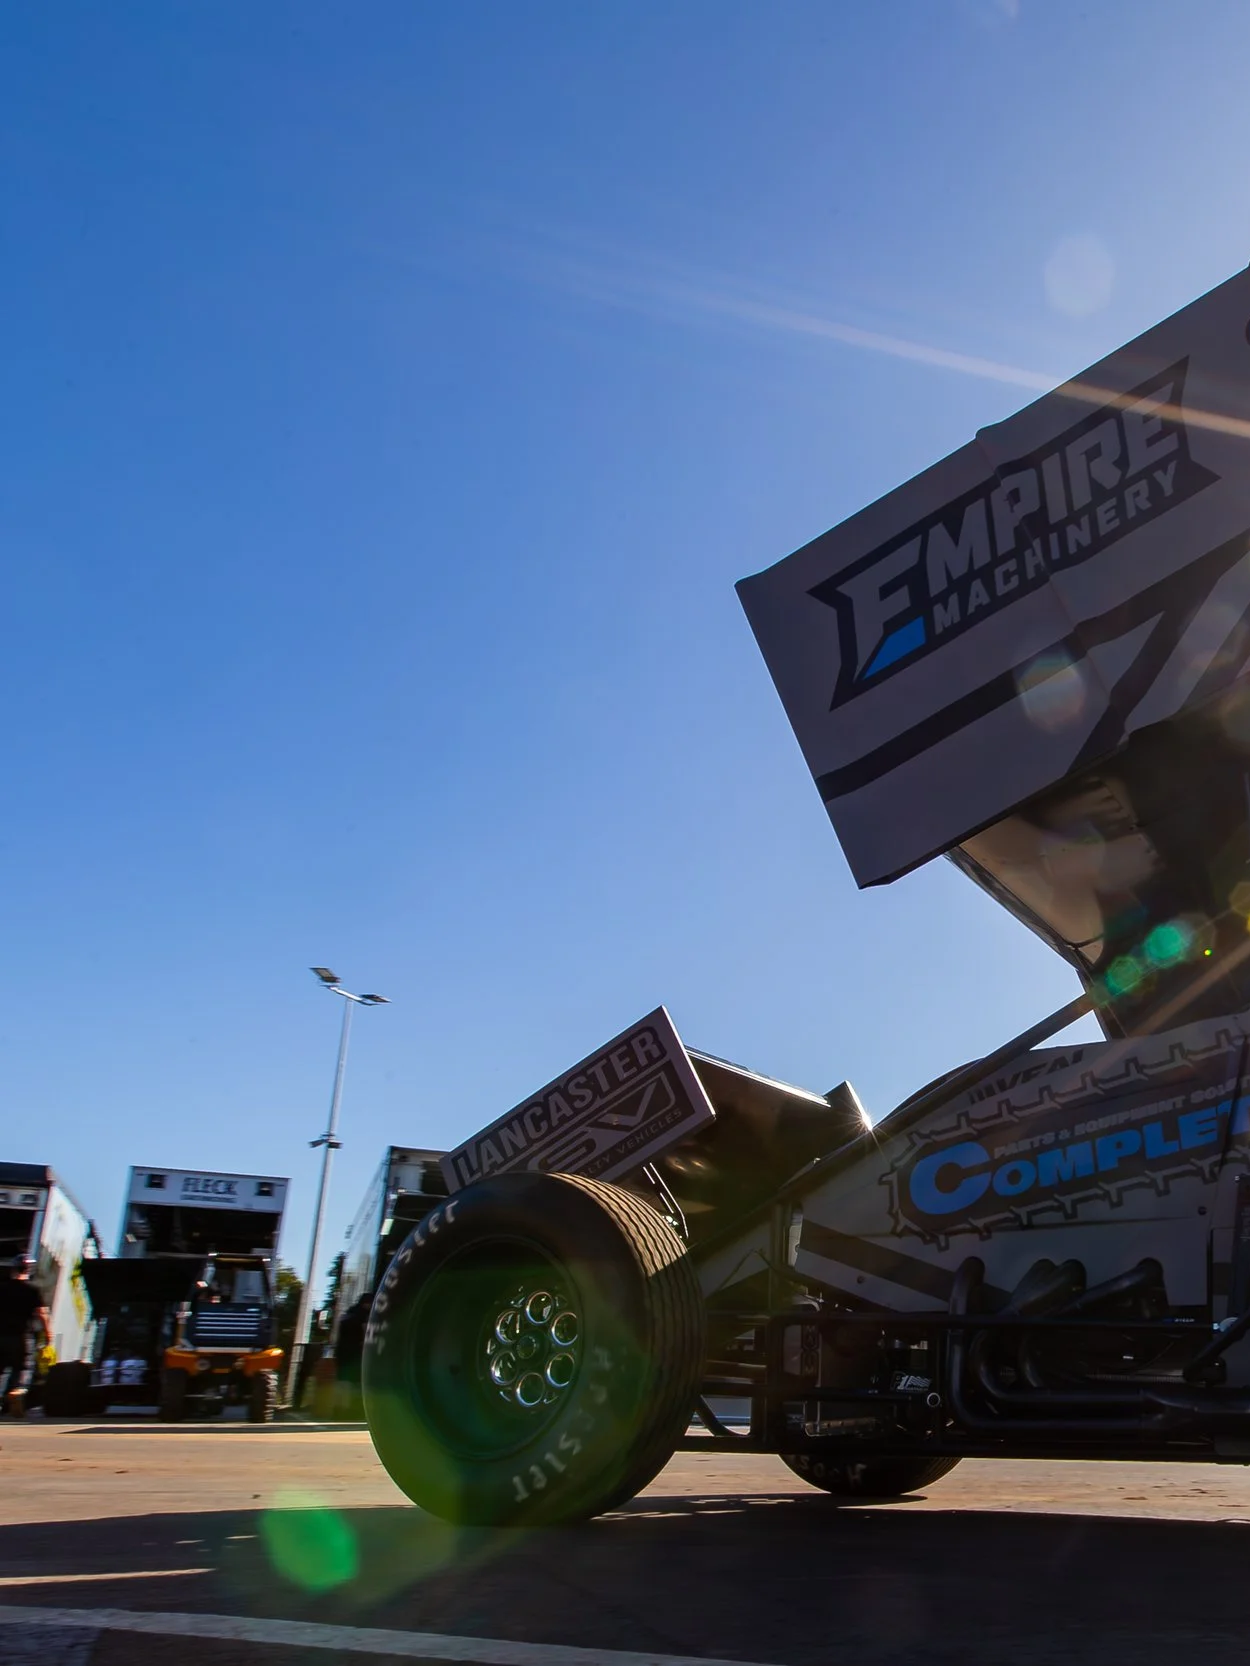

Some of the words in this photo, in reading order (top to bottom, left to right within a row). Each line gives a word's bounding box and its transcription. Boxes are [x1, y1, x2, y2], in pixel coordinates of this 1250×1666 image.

[834, 379, 1180, 685] EMPIRE
[930, 459, 1179, 636] MACHINERY
[454, 1029, 666, 1186] LANCASTER
[614, 1106, 683, 1156] VEHICLES
[993, 1131, 1056, 1159] PARTS
[1073, 1094, 1188, 1136] EQUIPMENT
[181, 1177, 240, 1195] FLECK
